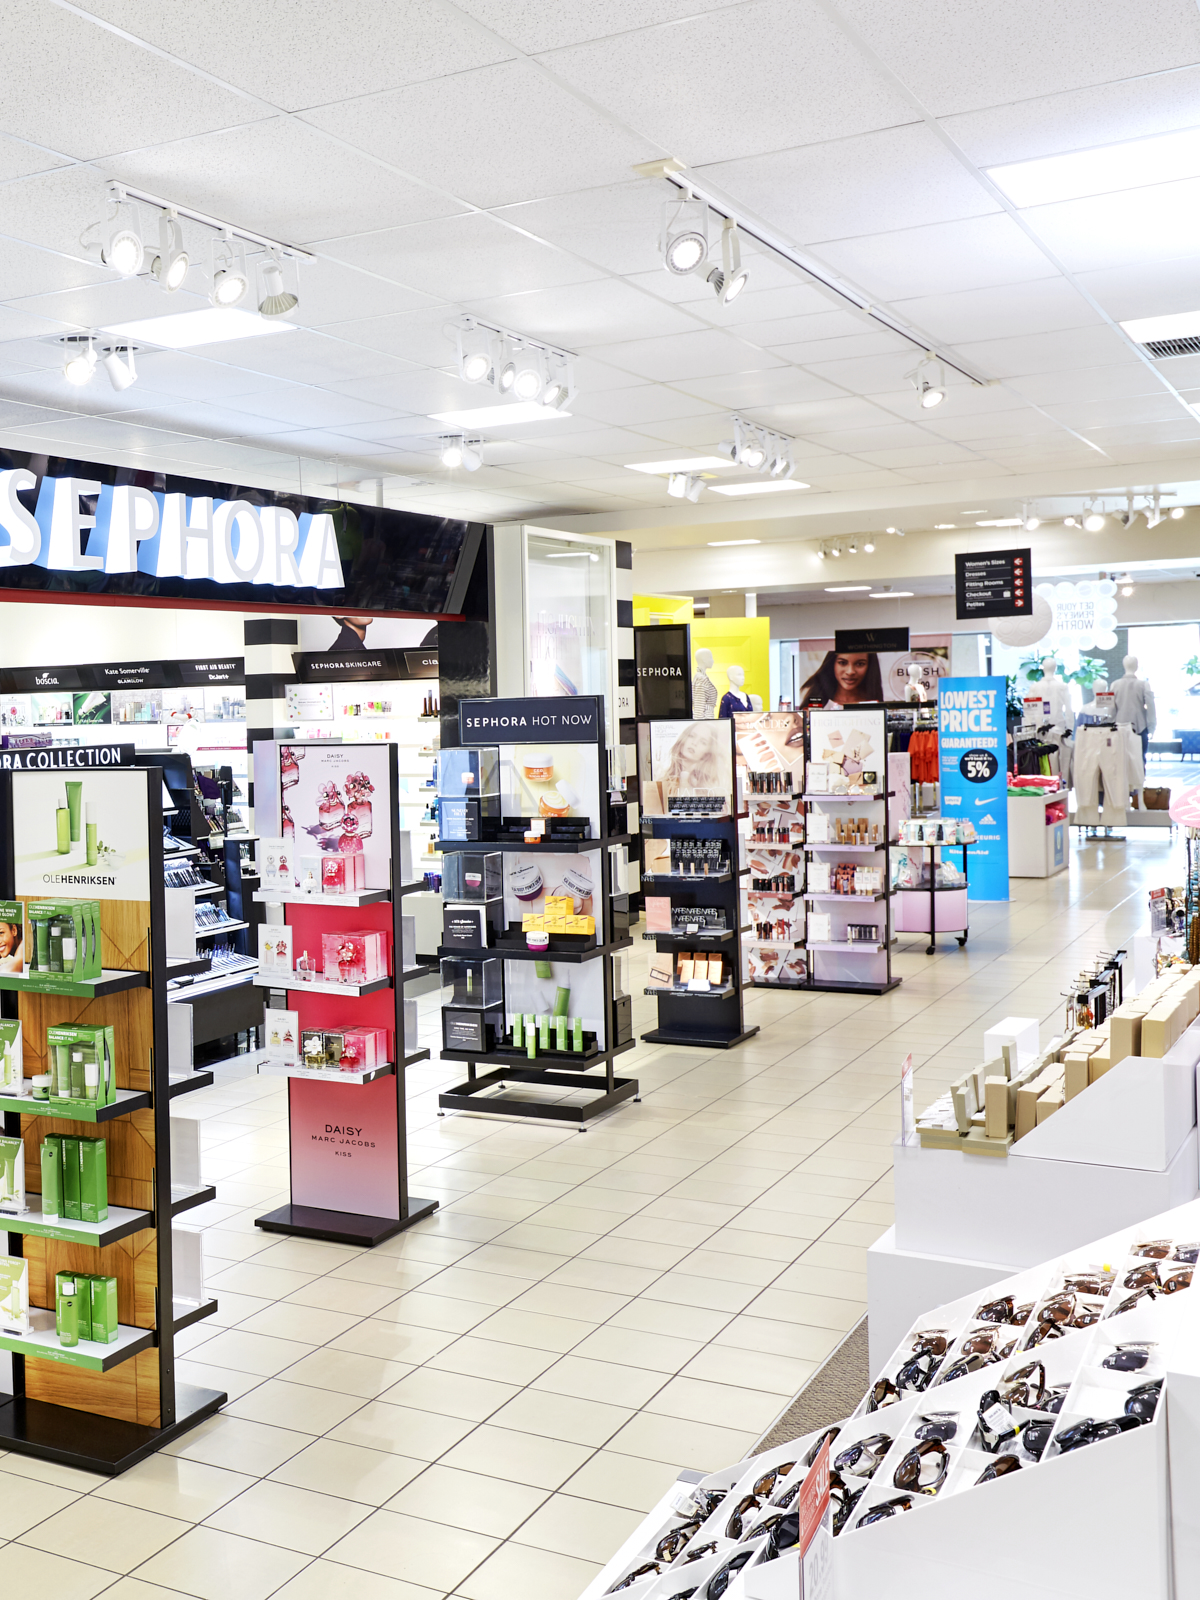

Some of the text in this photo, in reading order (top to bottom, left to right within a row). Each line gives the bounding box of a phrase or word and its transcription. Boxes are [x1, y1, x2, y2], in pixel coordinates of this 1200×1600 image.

[119, 667, 150, 675] Somerville
[311, 660, 382, 670] SEPHORA SKINCARE
[637, 667, 682, 677] SEPHORA
[897, 667, 939, 677] BLSH
[940, 690, 997, 709] LOWEST
[466, 715, 592, 728] SEPHORA HOT NOW
[756, 719, 789, 729] NUDES
[813, 718, 881, 727] HIGHLIGHTING
[940, 709, 997, 732] PRICE.
[941, 737, 998, 748] GUARANTEED!
[26, 747, 121, 768] COLLECTION
[967, 761, 990, 778] 5%
[43, 874, 115, 886] OLEHENRIKSEN
[325, 1124, 362, 1136] DAISY
[311, 1135, 376, 1148] MARC JACOBS
[815, 1454, 829, 1507] SALE
